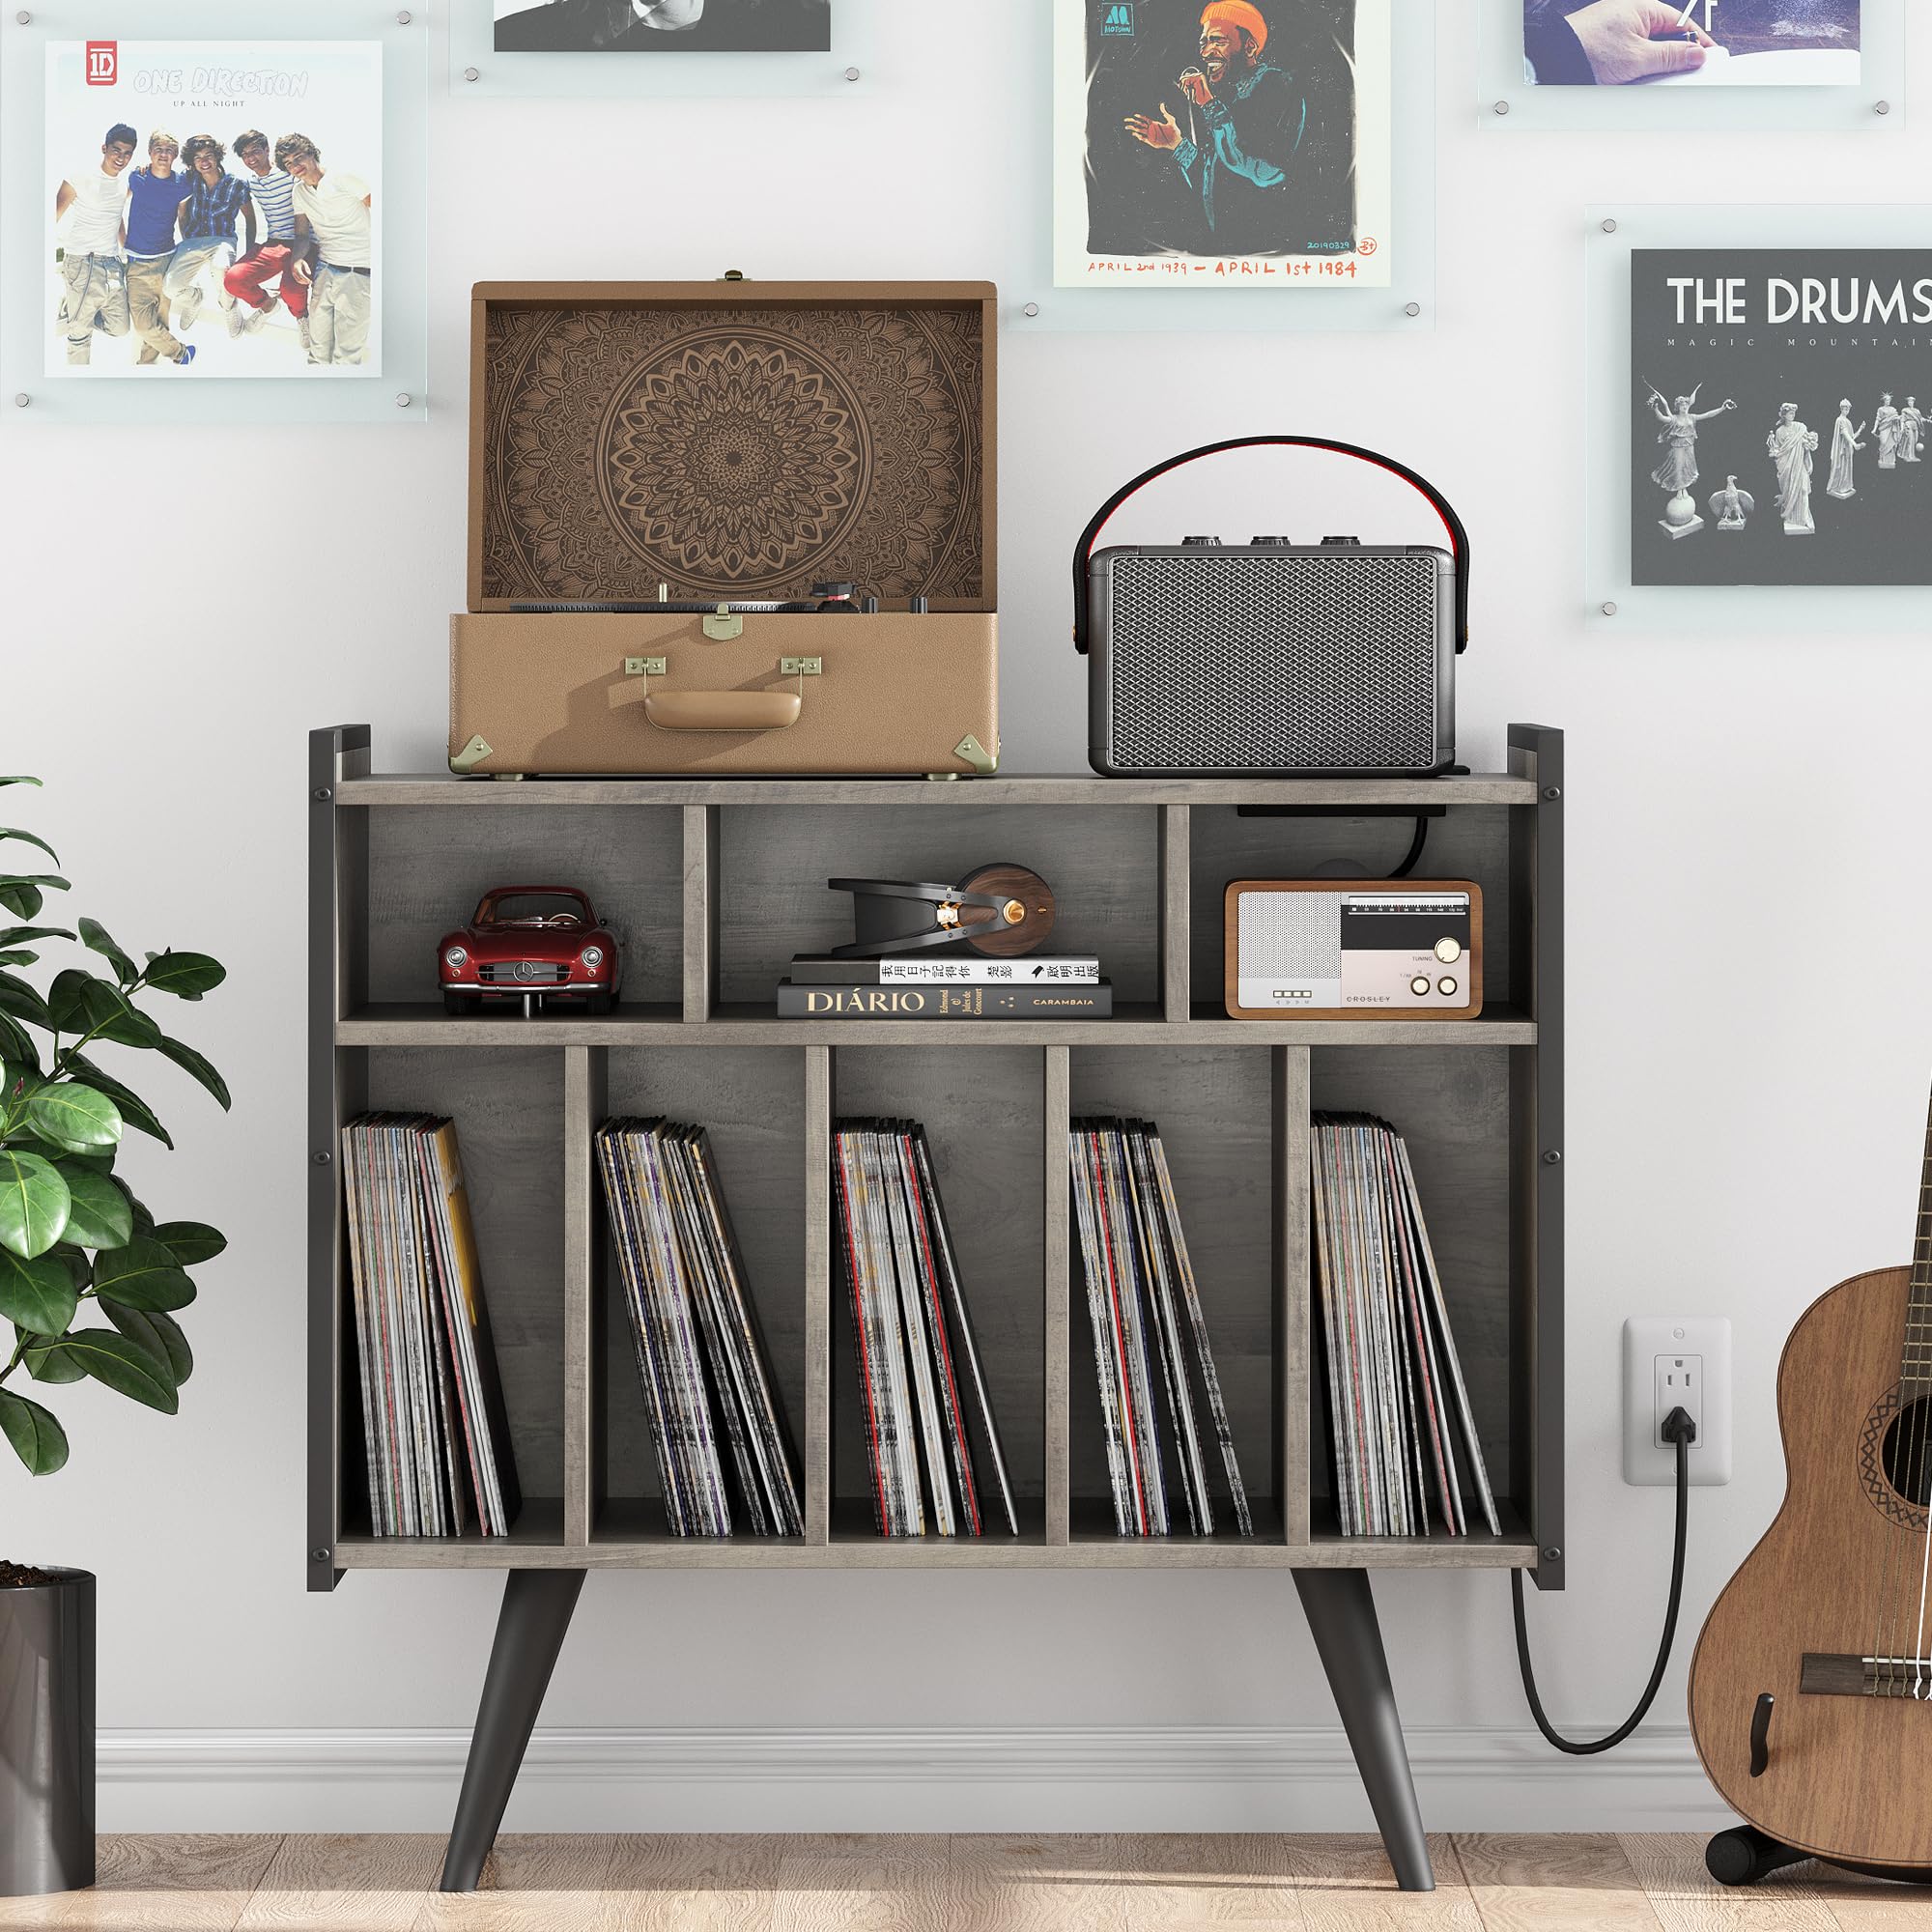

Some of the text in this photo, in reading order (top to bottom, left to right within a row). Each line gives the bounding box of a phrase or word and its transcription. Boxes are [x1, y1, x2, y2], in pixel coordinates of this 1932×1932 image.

[90, 52, 115, 76] 1D
[133, 67, 309, 98] ONE DIRECTION
[1088, 262, 1132, 271] APRIL
[1136, 263, 1155, 271] 2nd
[1161, 263, 1187, 275] 1939
[1214, 261, 1276, 277] APRIL
[1286, 261, 1312, 276] 1st
[1319, 261, 1358, 278] 1984
[1666, 277, 1932, 326] THE DRUMS
[1667, 338, 1932, 347] MAGIC MOUNTAI
[881, 964, 971, 979] 我用日子記得你
[806, 987, 926, 1012] DIÁRIO
